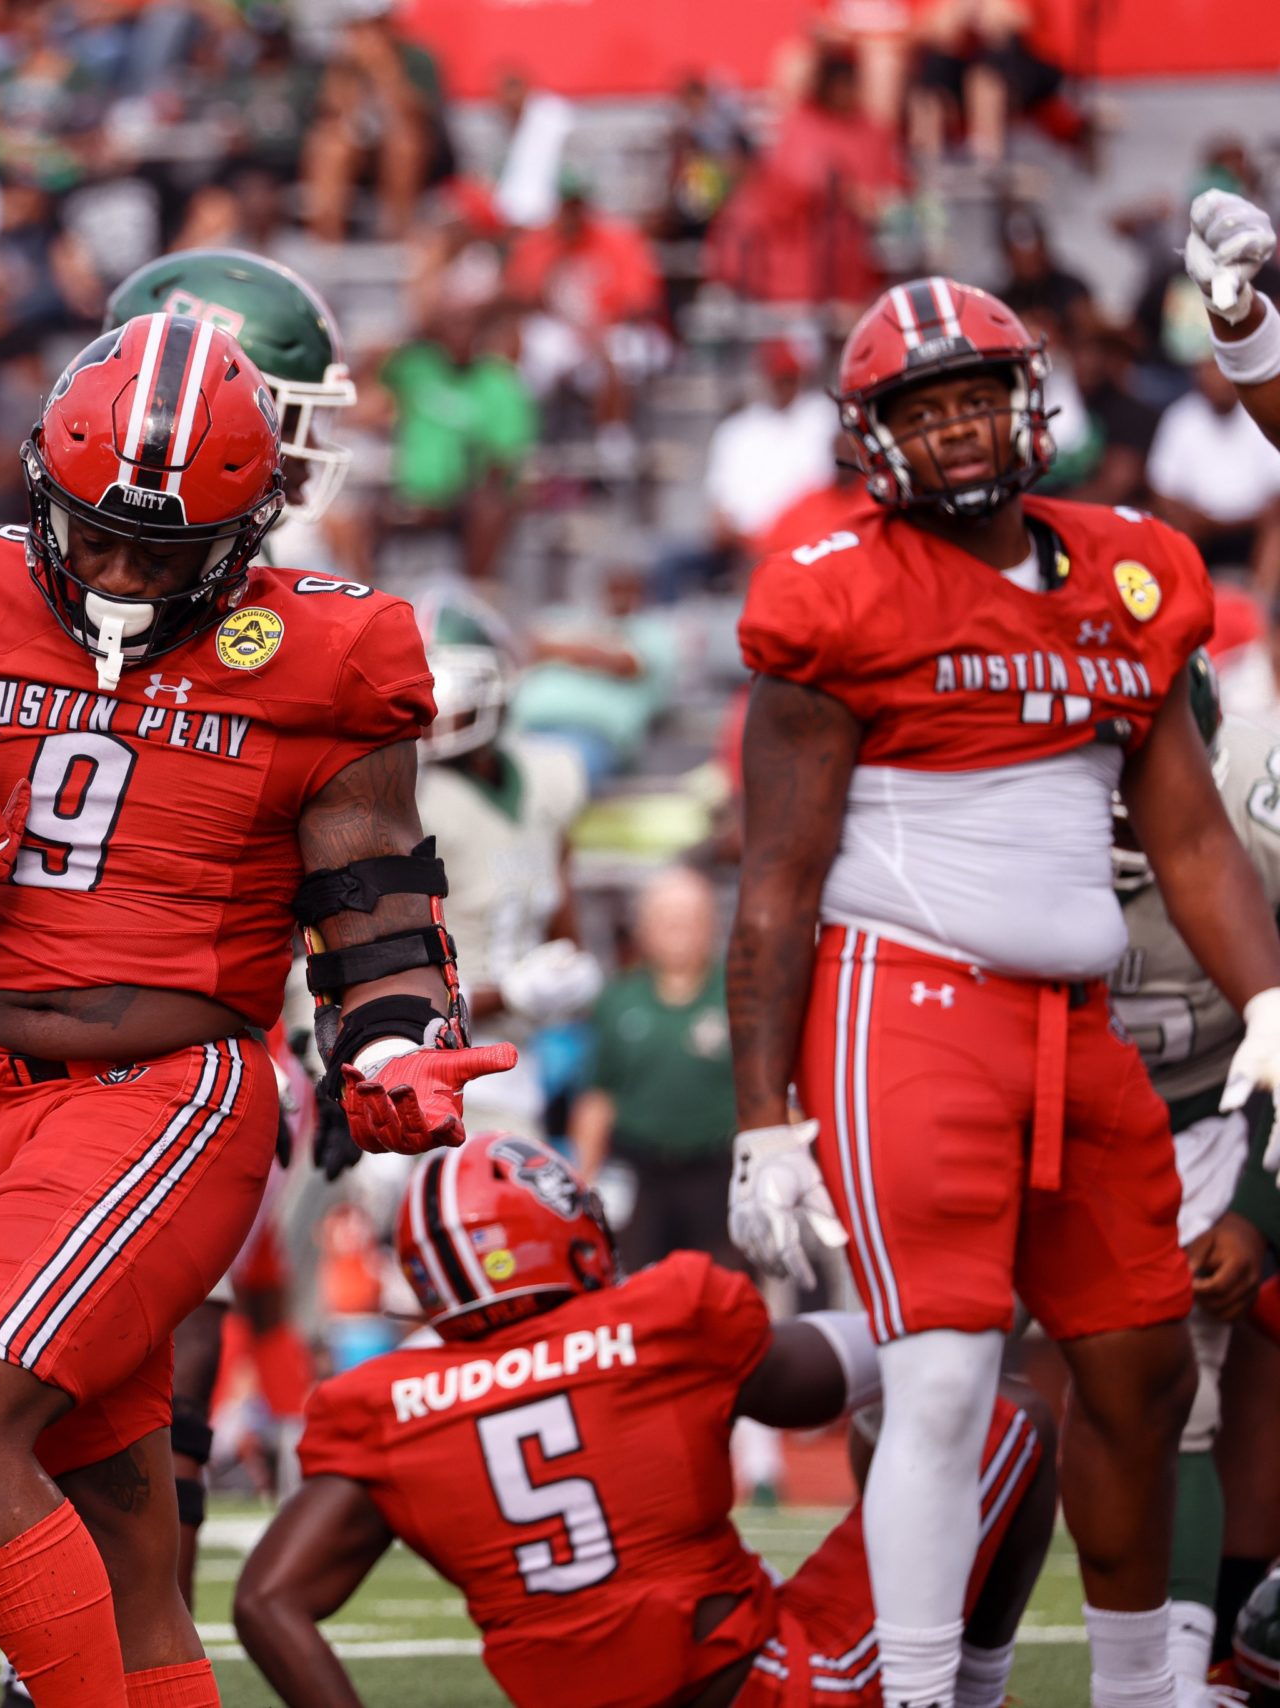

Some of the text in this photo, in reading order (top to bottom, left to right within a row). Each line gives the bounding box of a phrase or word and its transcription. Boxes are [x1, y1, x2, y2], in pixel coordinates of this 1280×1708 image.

[122, 488, 167, 511] UNITY
[293, 576, 374, 599] 9
[232, 611, 276, 626] INAUGURAL
[220, 641, 276, 666] FOOTBALL SEASON
[934, 651, 1151, 697] AUSTIN PEAY
[137, 705, 253, 759] PEAY
[8, 731, 138, 892] 9
[390, 1322, 637, 1424] RUDOLPH
[474, 1391, 619, 1595] 5
